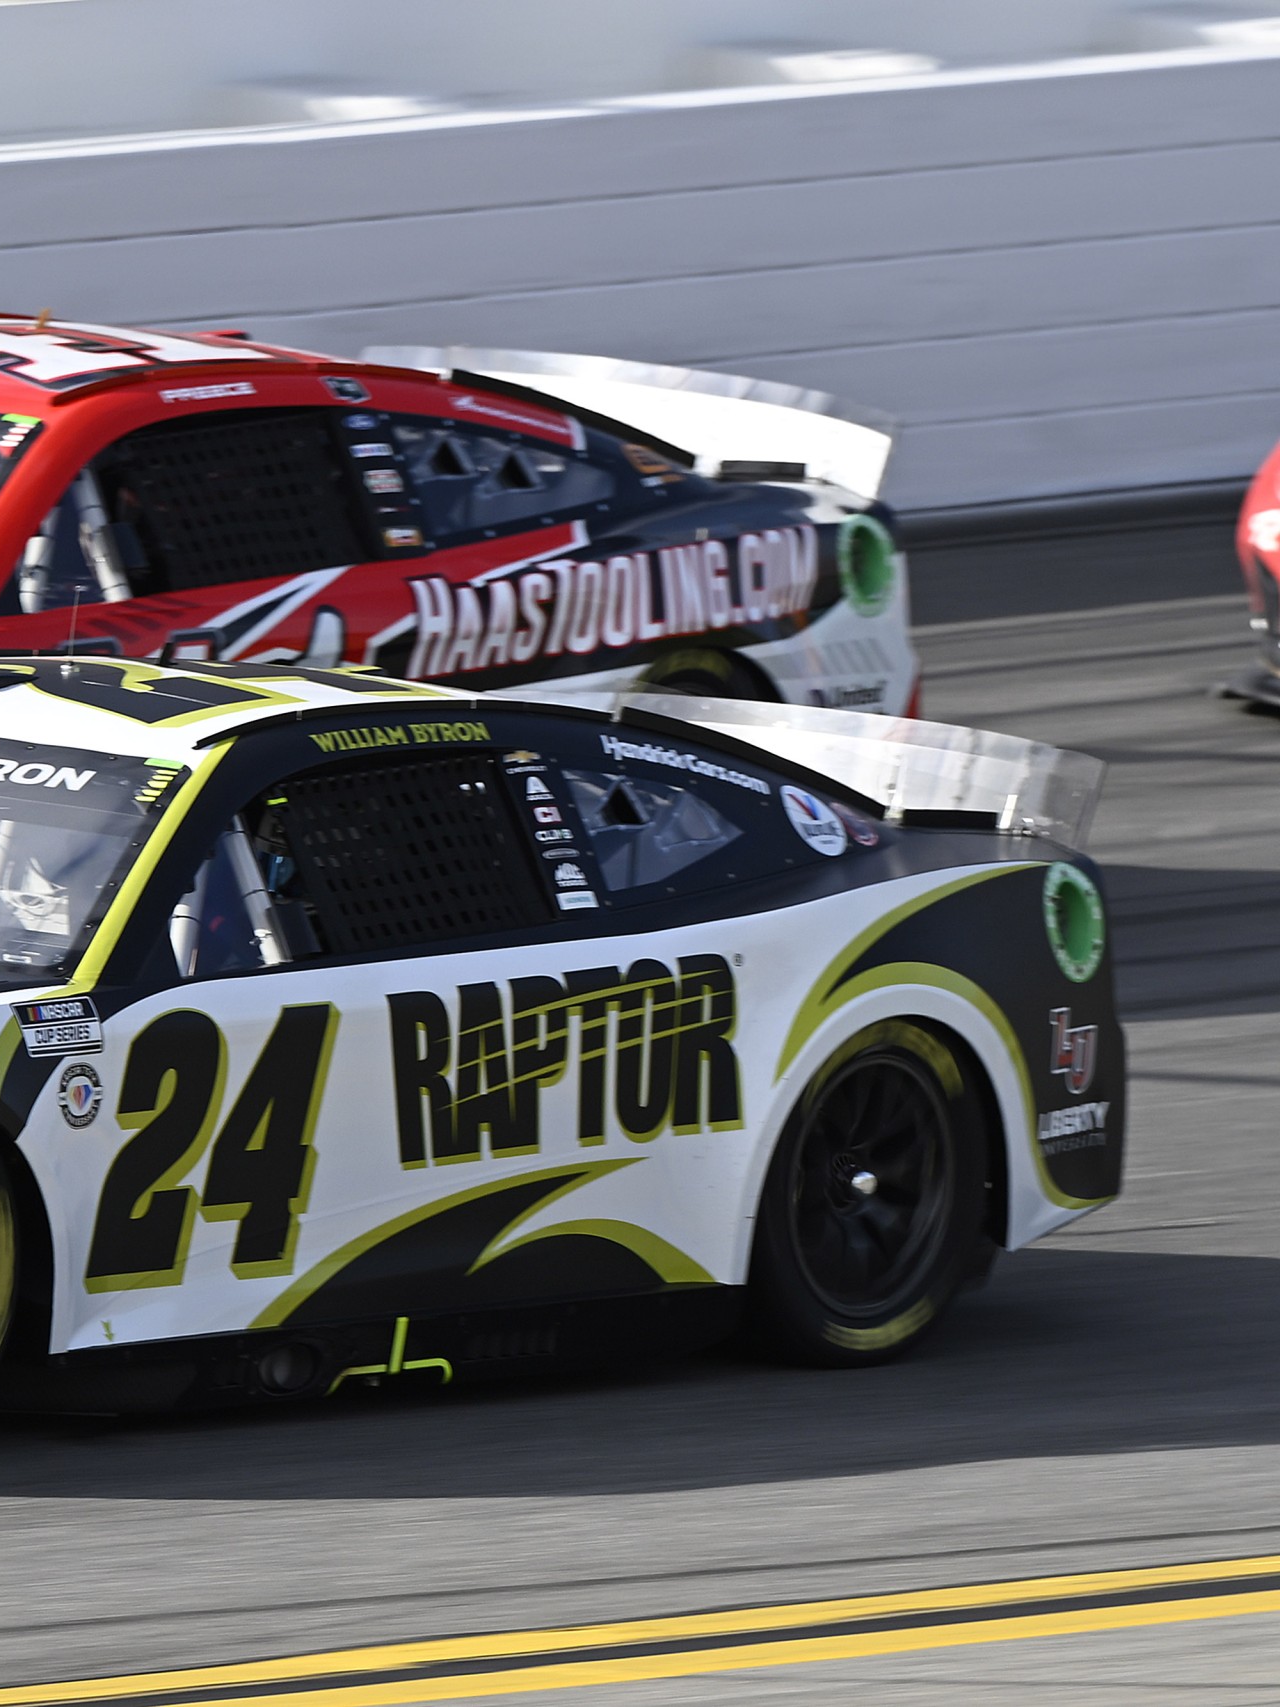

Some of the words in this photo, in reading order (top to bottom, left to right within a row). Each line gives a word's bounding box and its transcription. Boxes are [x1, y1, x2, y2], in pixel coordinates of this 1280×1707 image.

[158, 381, 257, 403] PREECE
[405, 523, 819, 681] HAASTOOLING.COM
[309, 725, 410, 752] WILLIAM
[408, 722, 491, 743] BYRON
[600, 734, 771, 795] HendrickCars.com
[39, 1002, 85, 1020] NASCAR
[34, 1028, 54, 1044] CUP
[56, 1024, 90, 1042] SERIES
[386, 952, 744, 1170] RAPTOR
[86, 1000, 340, 1294] 24
